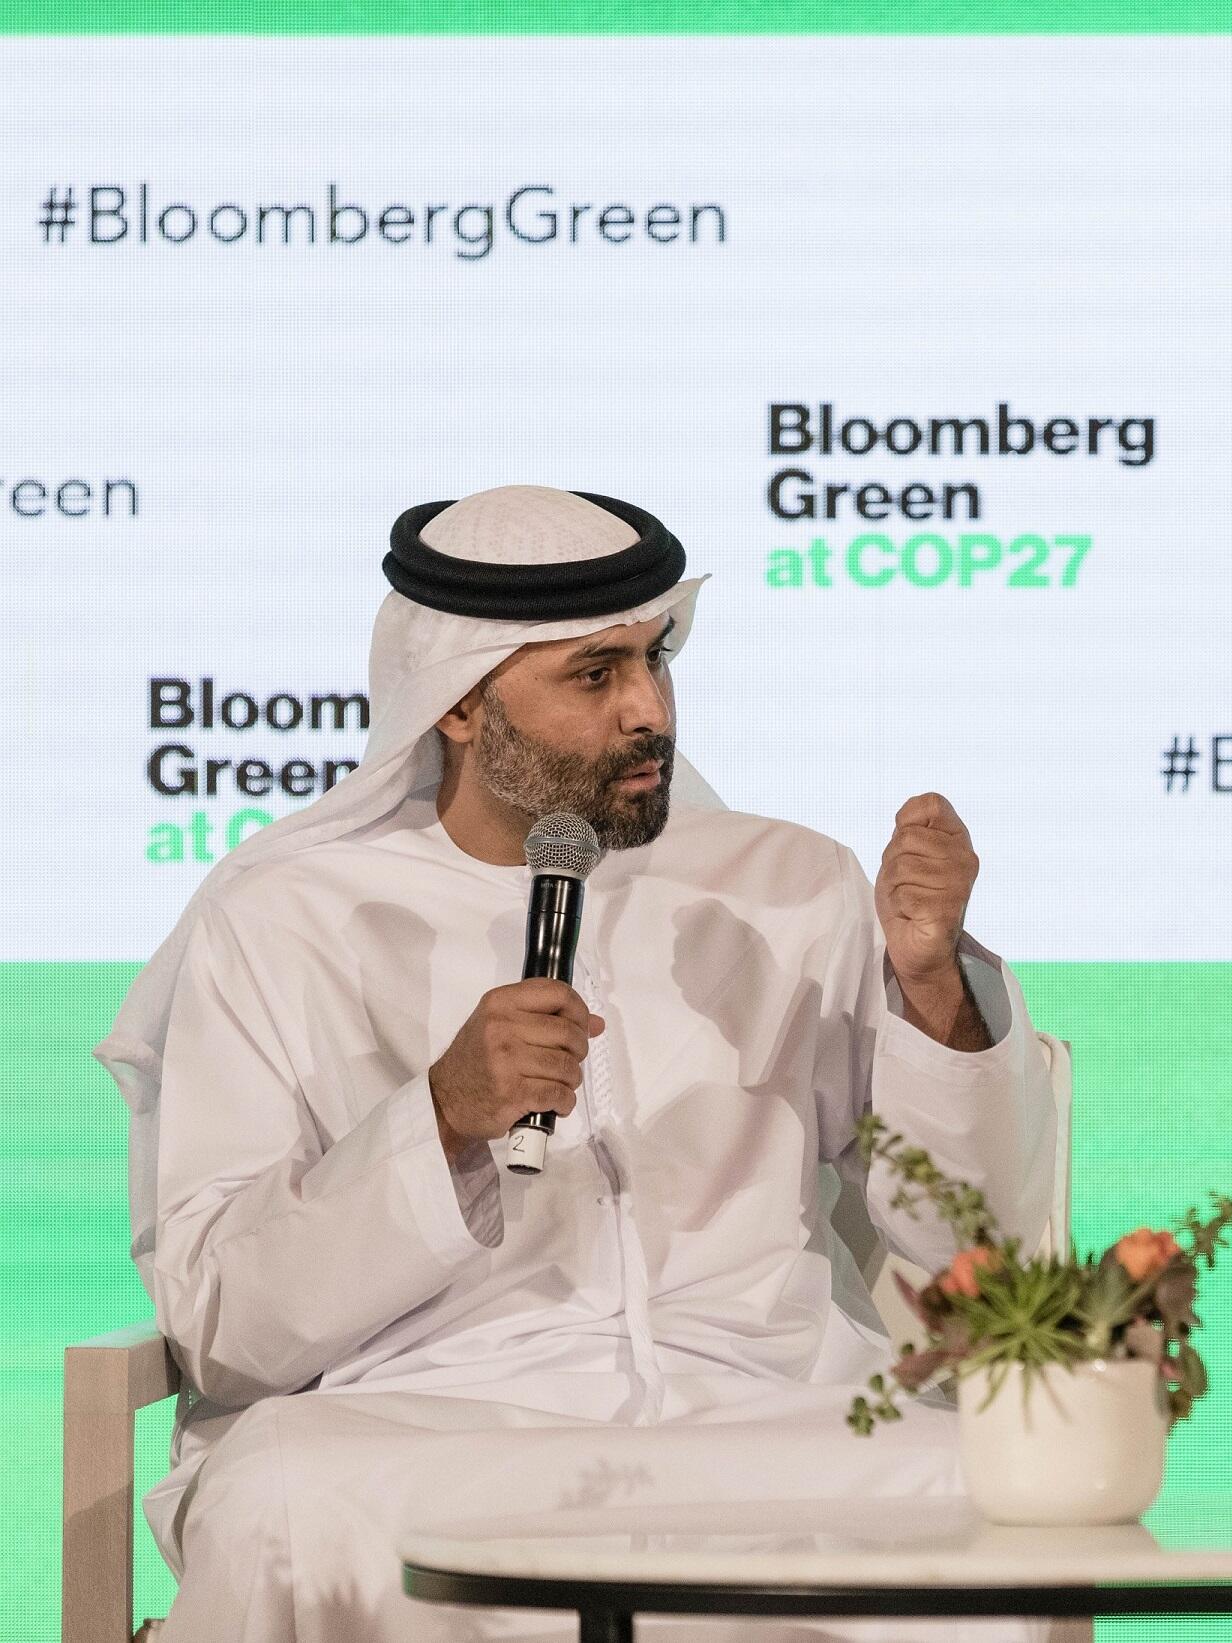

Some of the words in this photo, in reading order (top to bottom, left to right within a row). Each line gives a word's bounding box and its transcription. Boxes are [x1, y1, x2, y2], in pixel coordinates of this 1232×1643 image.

[38, 182, 727, 261] #BloombergGreen
[768, 402, 1156, 467] Bloomberg
[0, 477, 139, 517] een
[766, 467, 982, 522] Green
[765, 537, 833, 588] at
[844, 533, 1094, 588] COP27
[146, 810, 214, 862] at
[512, 1135, 525, 1153] 2
